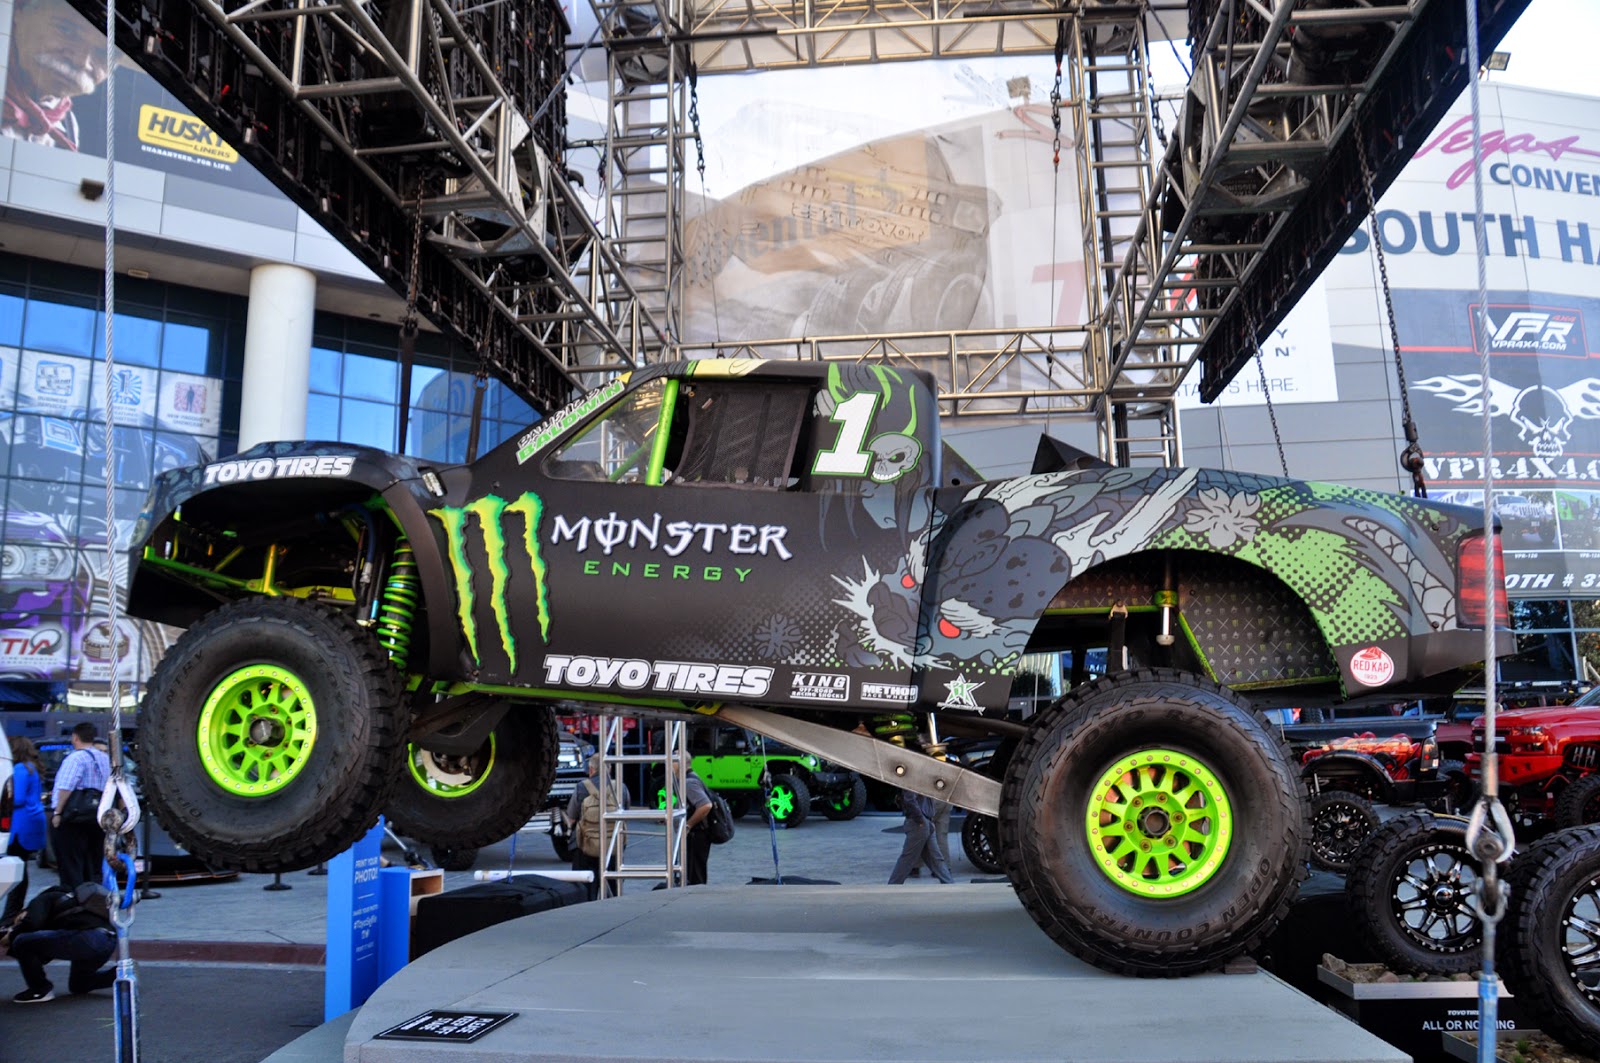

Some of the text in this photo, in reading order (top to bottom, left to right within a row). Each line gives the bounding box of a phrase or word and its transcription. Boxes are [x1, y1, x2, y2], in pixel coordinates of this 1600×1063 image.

[193, 144, 230, 159] LINERS
[1556, 219, 1600, 266] H
[1477, 312, 1574, 343] VPR
[1492, 340, 1567, 351] VPR4X4.COM
[1247, 378, 1299, 393] HERE.
[516, 381, 625, 465] BALDWIN
[811, 390, 882, 477] 1
[203, 456, 357, 485] TOYO TIRES
[551, 511, 793, 561] MONSTER
[584, 560, 752, 582] ENERGY
[543, 655, 776, 697] TOYO TIRES
[1353, 660, 1389, 672] RED KAP
[792, 674, 846, 688] KING
[862, 684, 917, 696] METHOD
[1082, 857, 1272, 942] OPEN COUNTRY
[1422, 1020, 1516, 1031] ALL OR NOING
